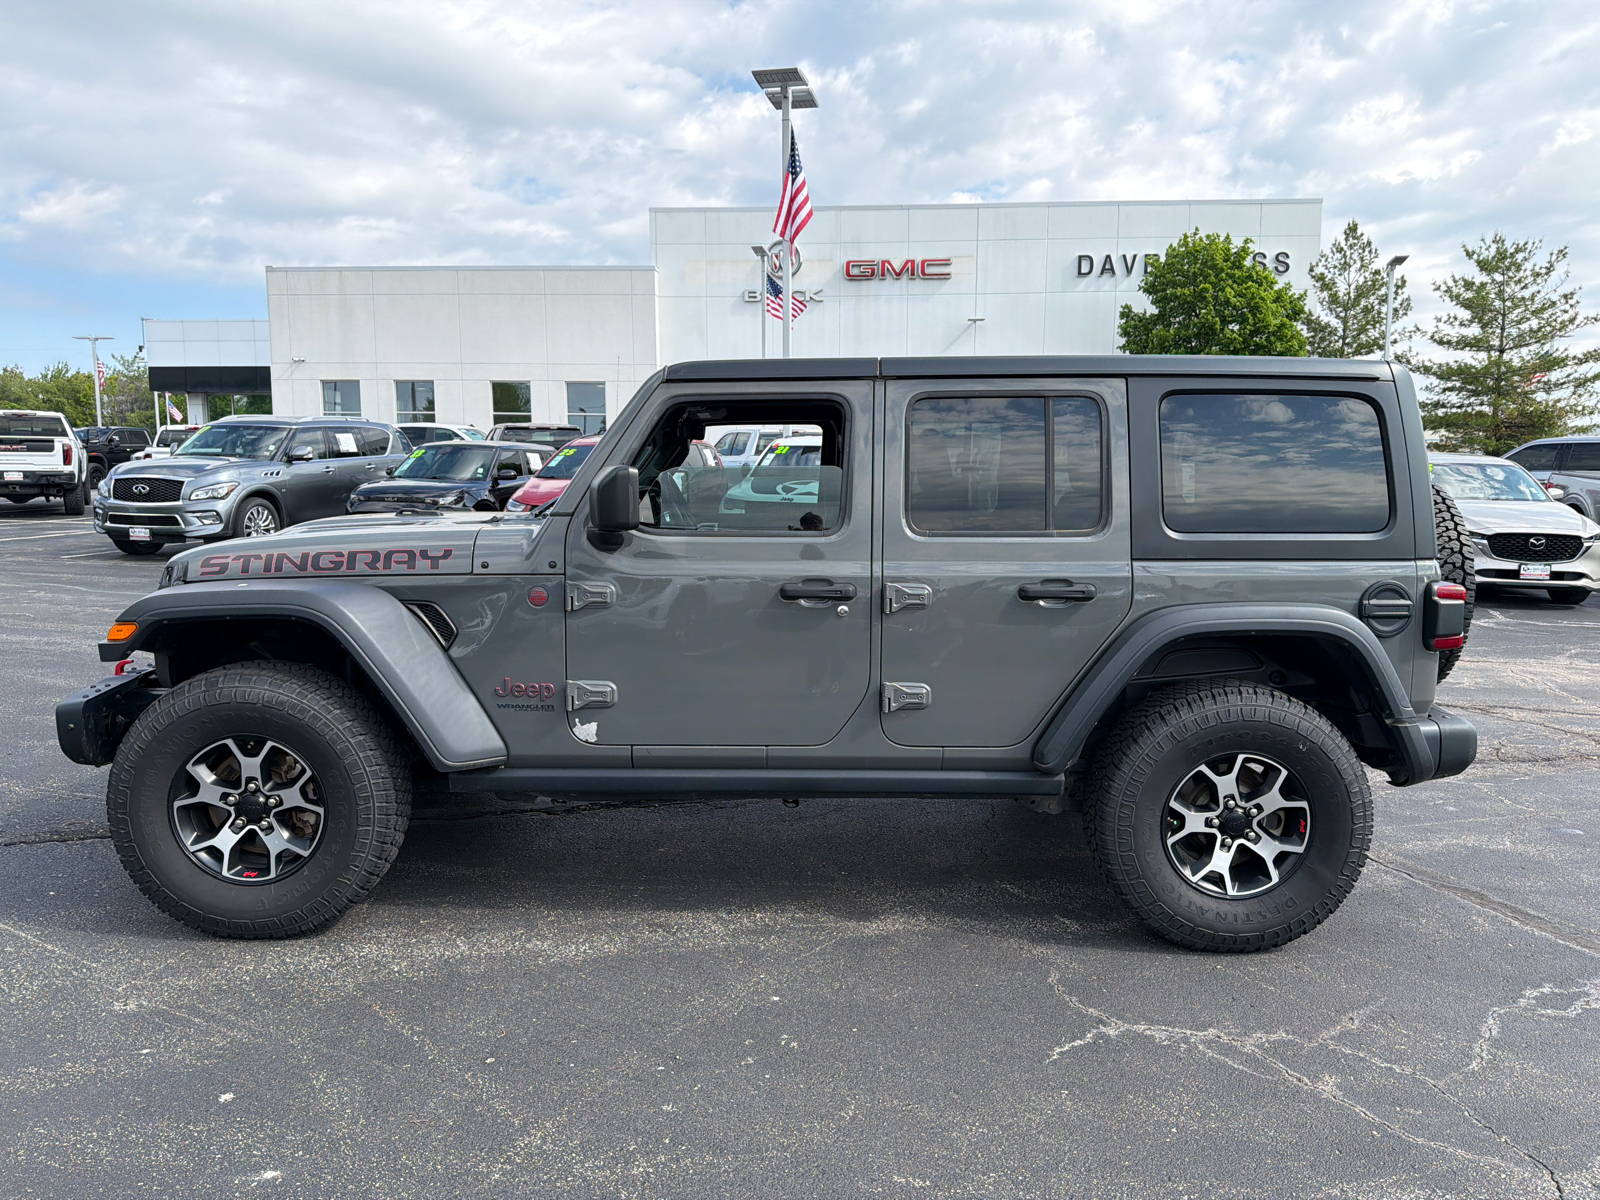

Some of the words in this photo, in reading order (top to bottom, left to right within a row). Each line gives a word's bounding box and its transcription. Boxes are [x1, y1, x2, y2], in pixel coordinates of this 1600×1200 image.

[844, 259, 952, 280] GMC
[558, 448, 578, 456] 25
[774, 446, 790, 454] 21
[199, 548, 454, 576] STINGRAY
[495, 677, 556, 702] Jeep
